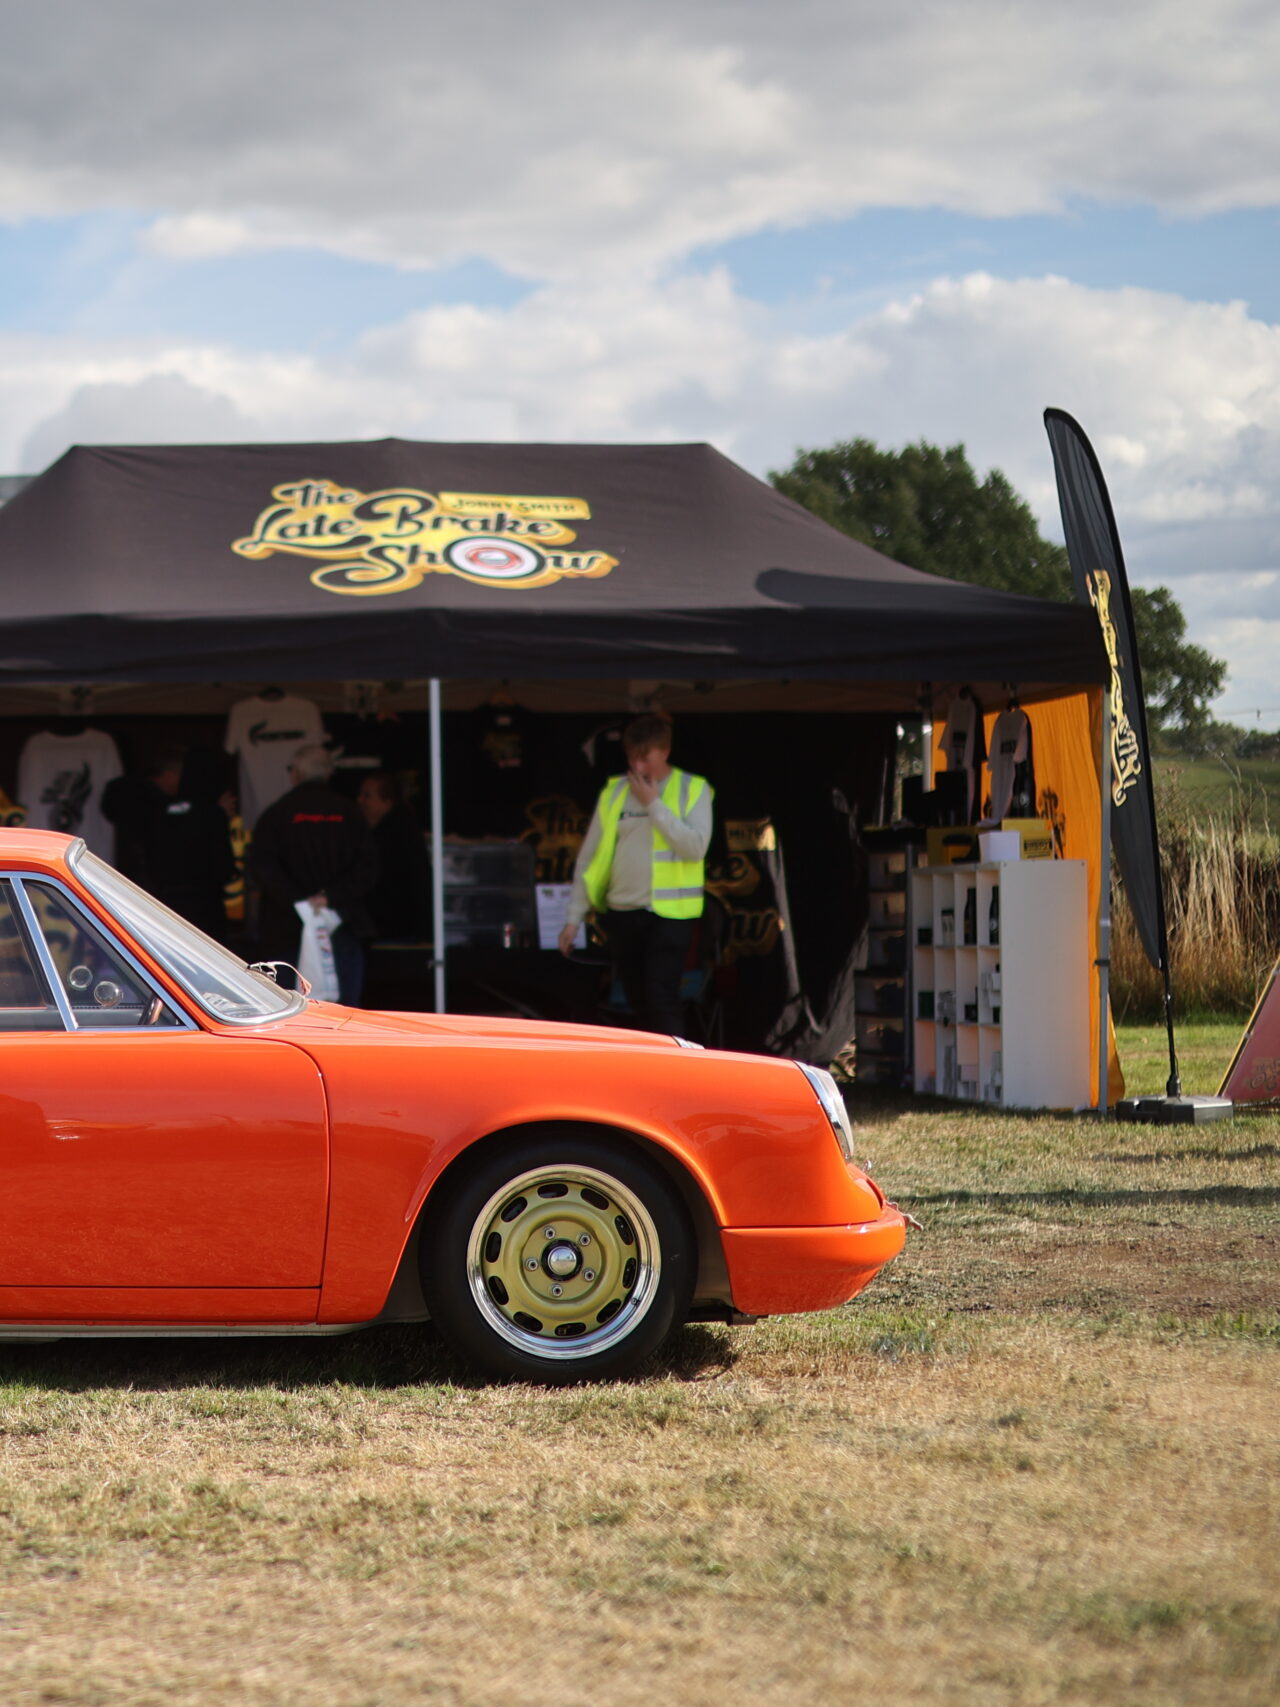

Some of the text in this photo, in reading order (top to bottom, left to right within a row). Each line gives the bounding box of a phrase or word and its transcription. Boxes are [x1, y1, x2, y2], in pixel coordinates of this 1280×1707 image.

[279, 483, 358, 507] The
[238, 493, 561, 550] Late Brake
